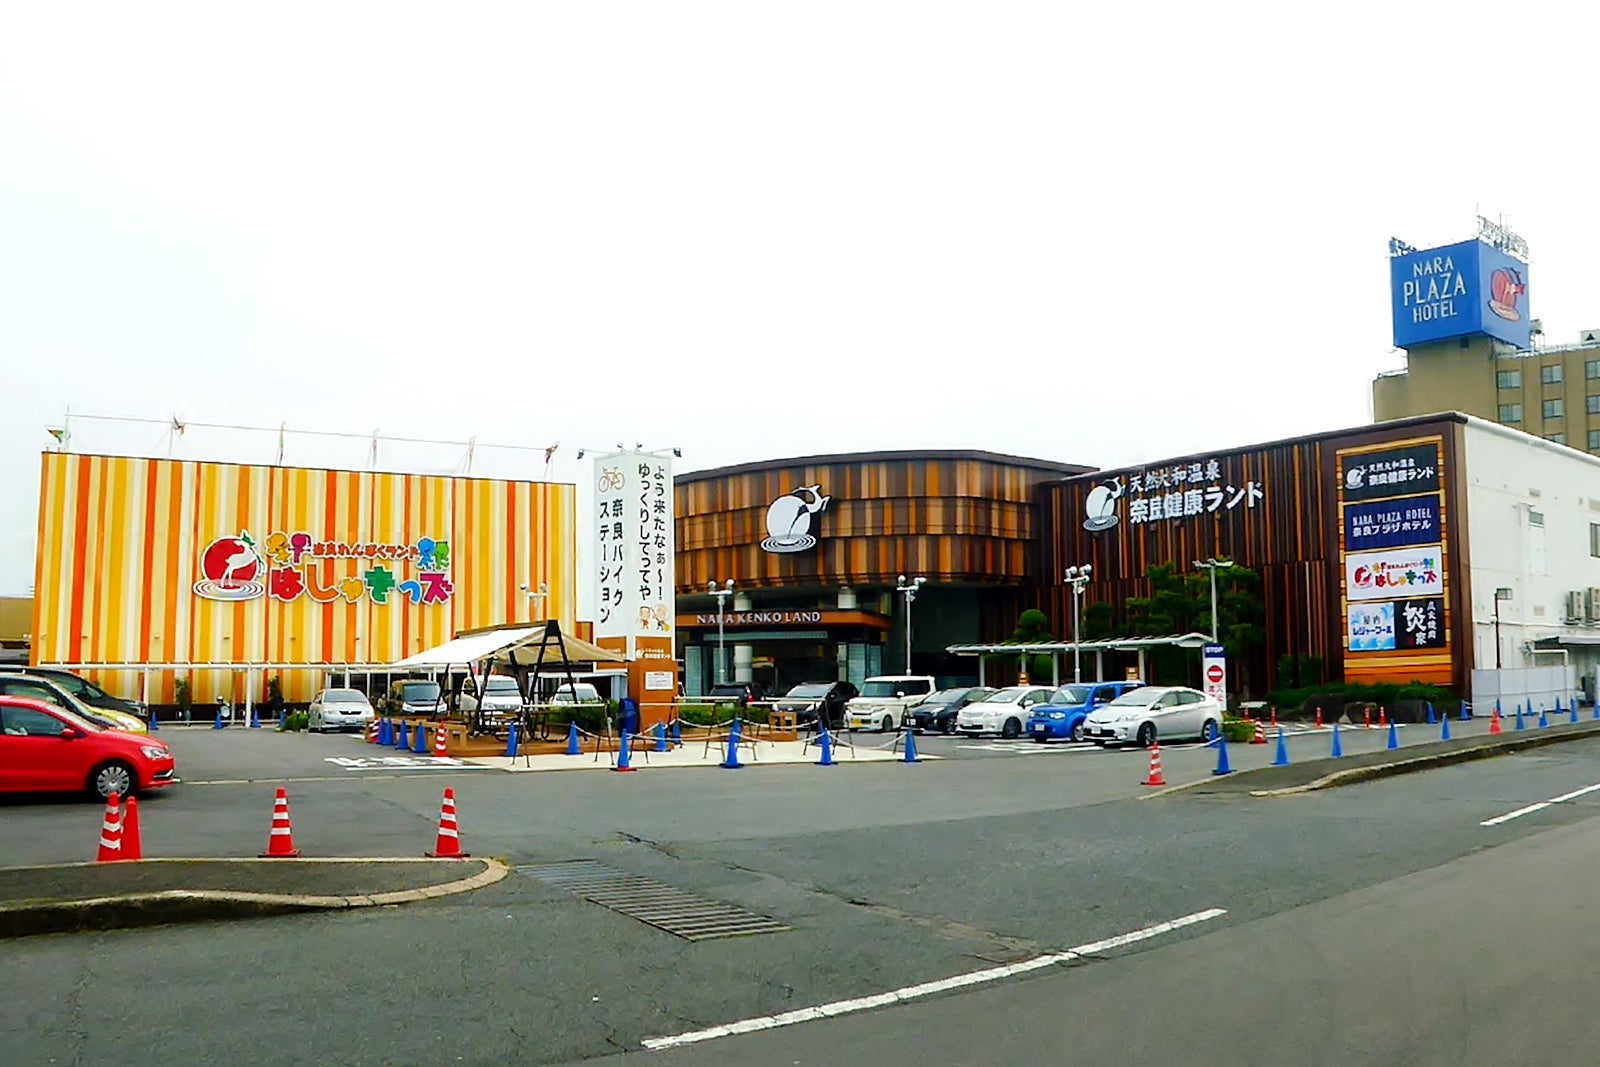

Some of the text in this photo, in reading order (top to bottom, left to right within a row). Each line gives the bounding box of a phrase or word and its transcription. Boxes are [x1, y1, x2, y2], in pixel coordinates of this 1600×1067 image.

[1413, 256, 1454, 278] NARA
[1403, 271, 1467, 307] PLAZA
[1413, 300, 1458, 323] HOTEL
[1130, 460, 1222, 493] 天然大和温泉
[1129, 481, 1264, 525] 奈良健康ランド
[1352, 508, 1432, 526] NARA PLAZA HOTEL
[638, 463, 651, 601] ゆっくりしてってや
[1352, 520, 1432, 538] 奈良プラザホテル
[599, 502, 610, 624] ステーション
[612, 498, 624, 607] 奈良バイク
[737, 612, 782, 624] KENKO
[785, 611, 821, 623] LAND
[1205, 646, 1224, 654] STOP
